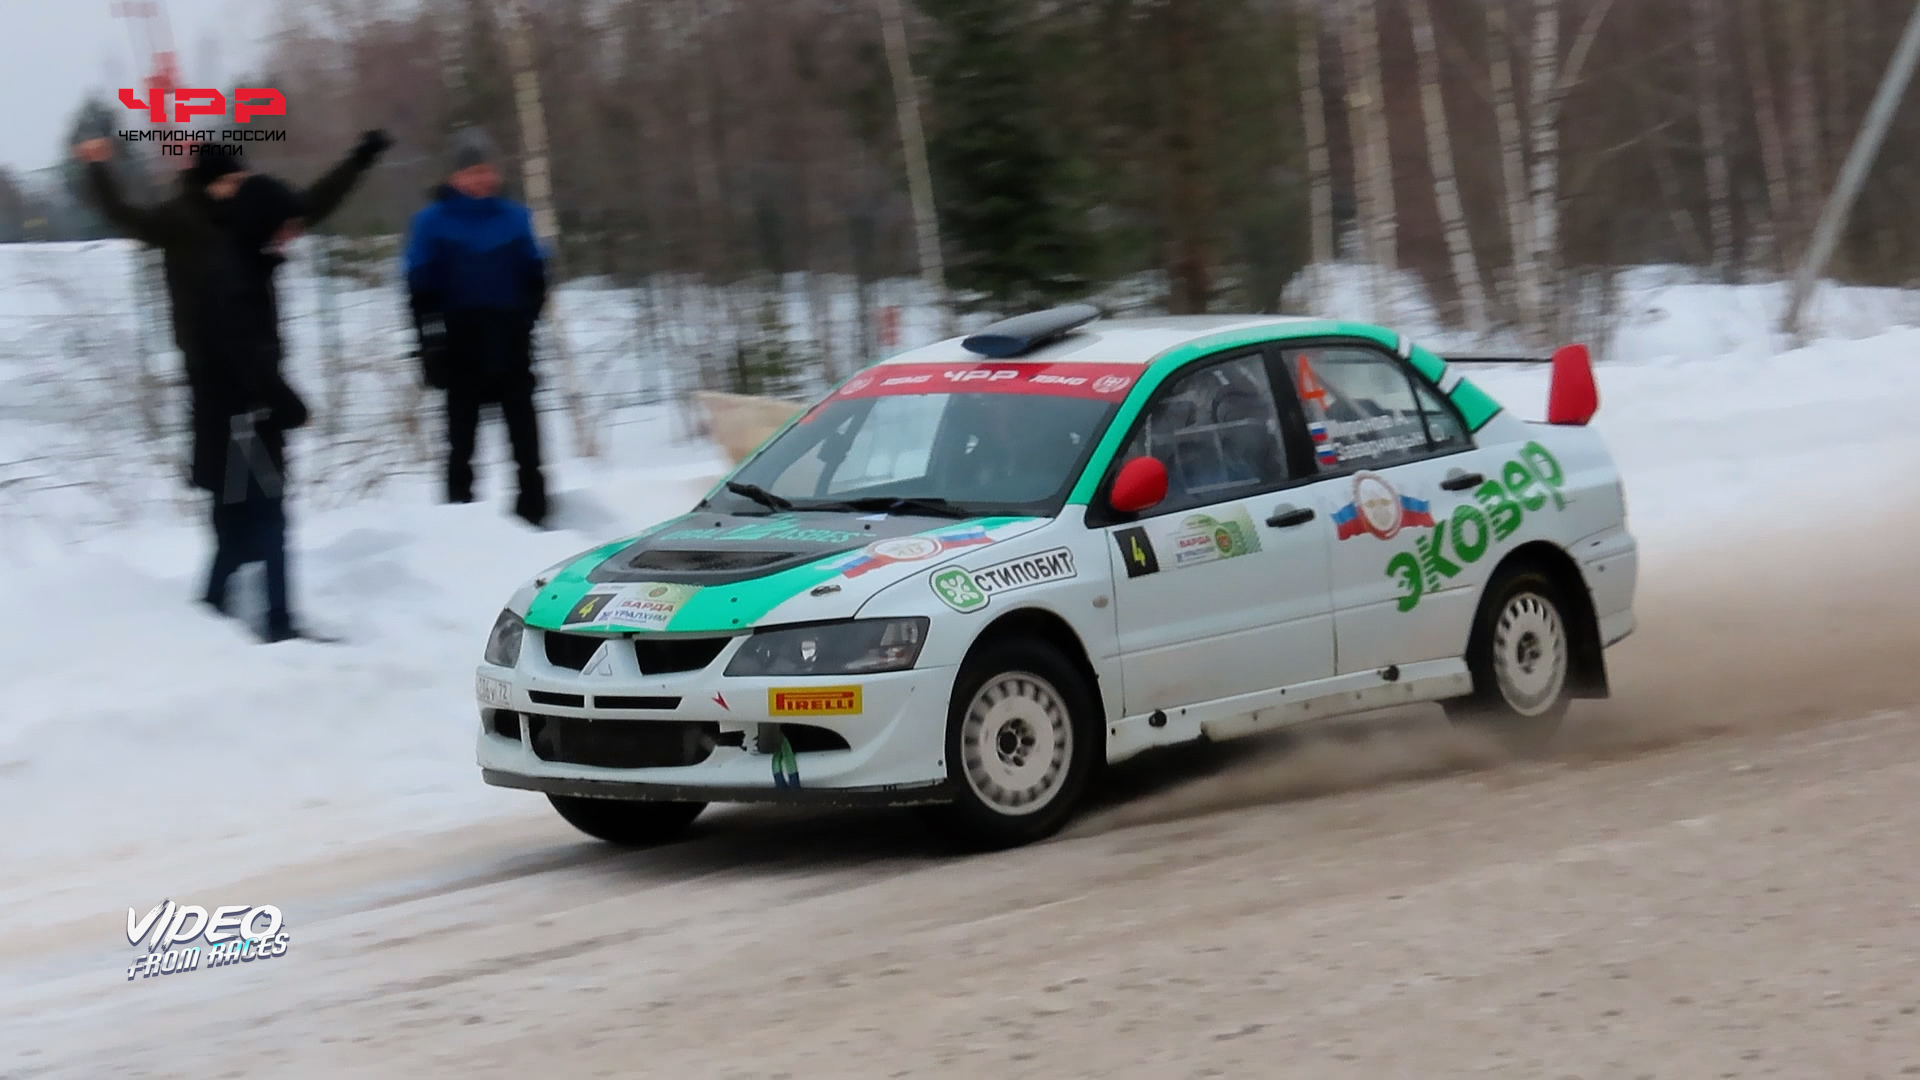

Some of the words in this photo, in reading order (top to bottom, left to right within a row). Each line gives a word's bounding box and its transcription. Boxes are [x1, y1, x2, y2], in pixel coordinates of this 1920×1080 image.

[943, 369, 1021, 382] ЧРР
[1296, 353, 1328, 411] 4
[1130, 535, 1147, 568] 4
[578, 596, 601, 619] 4
[775, 691, 855, 711] PIRELLI
